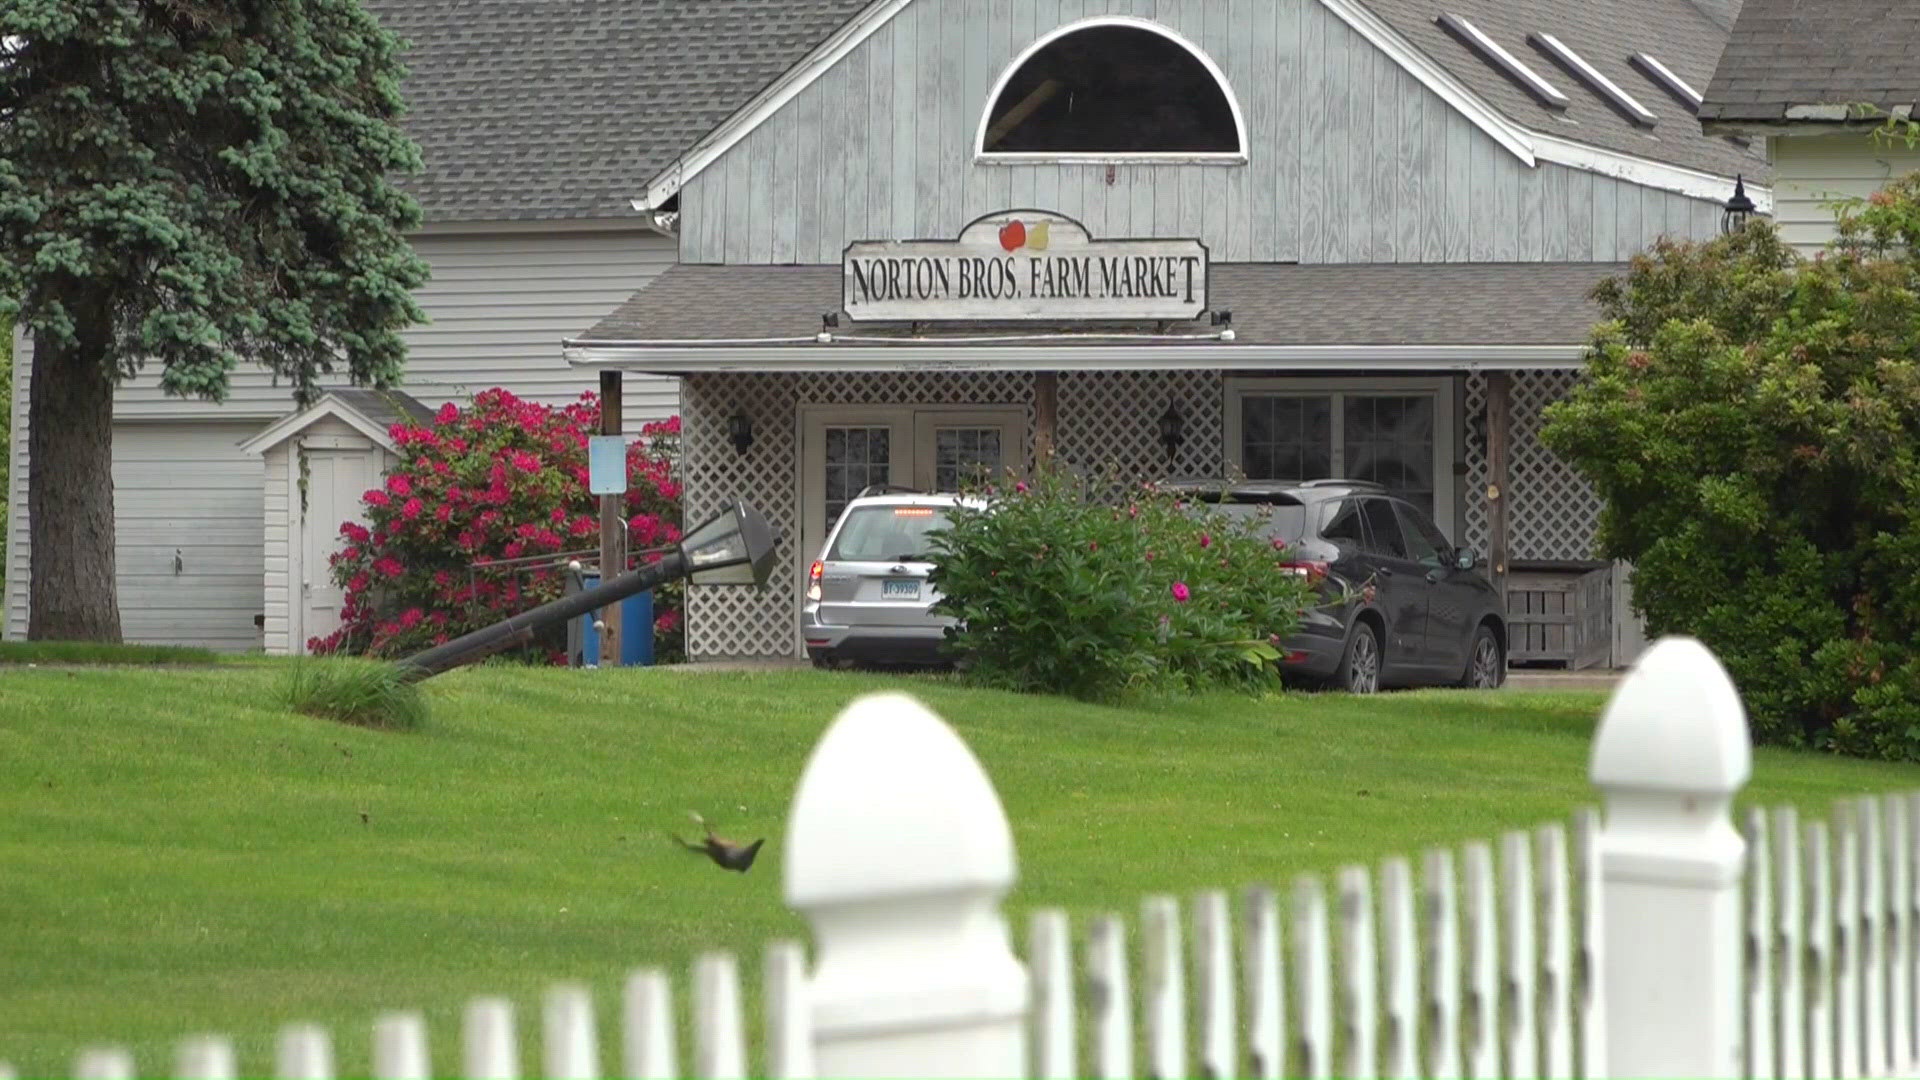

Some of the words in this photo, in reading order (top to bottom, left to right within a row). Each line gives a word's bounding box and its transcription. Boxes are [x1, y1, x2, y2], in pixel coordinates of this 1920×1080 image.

[850, 258, 950, 304] NORTON
[957, 257, 1022, 300] BROS.
[1029, 256, 1091, 298] FARM
[1098, 256, 1200, 303] MARKET
